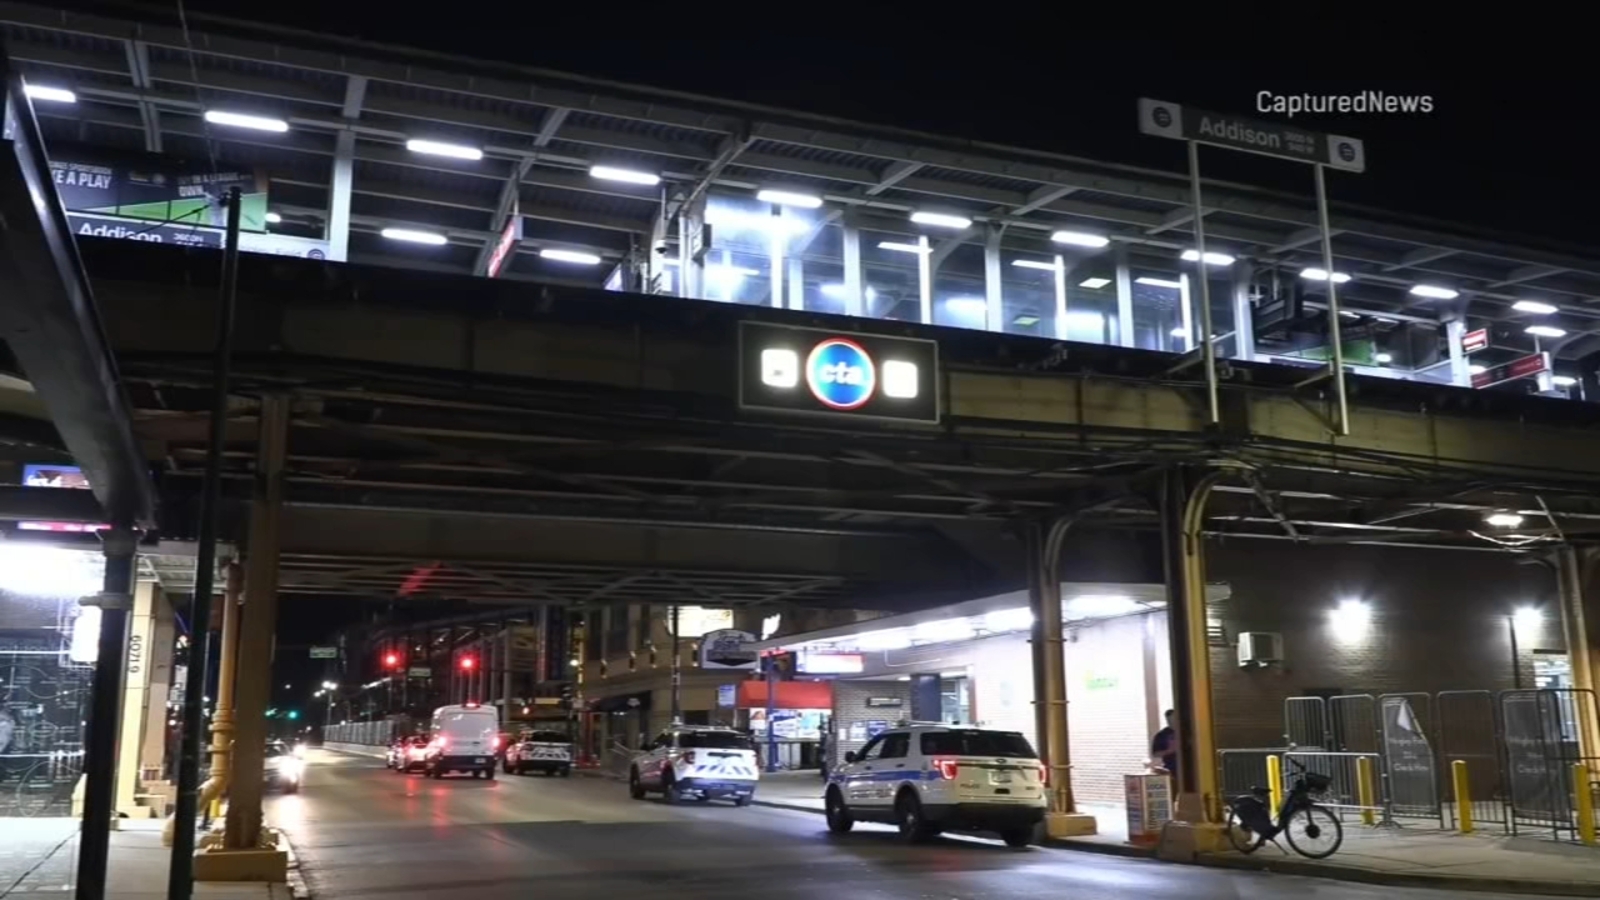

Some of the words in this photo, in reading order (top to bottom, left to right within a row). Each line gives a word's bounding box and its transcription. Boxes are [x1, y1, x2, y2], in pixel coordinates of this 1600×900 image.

[1199, 116, 1282, 149] Addison
[66, 171, 76, 186] A
[79, 172, 112, 190] PLAY
